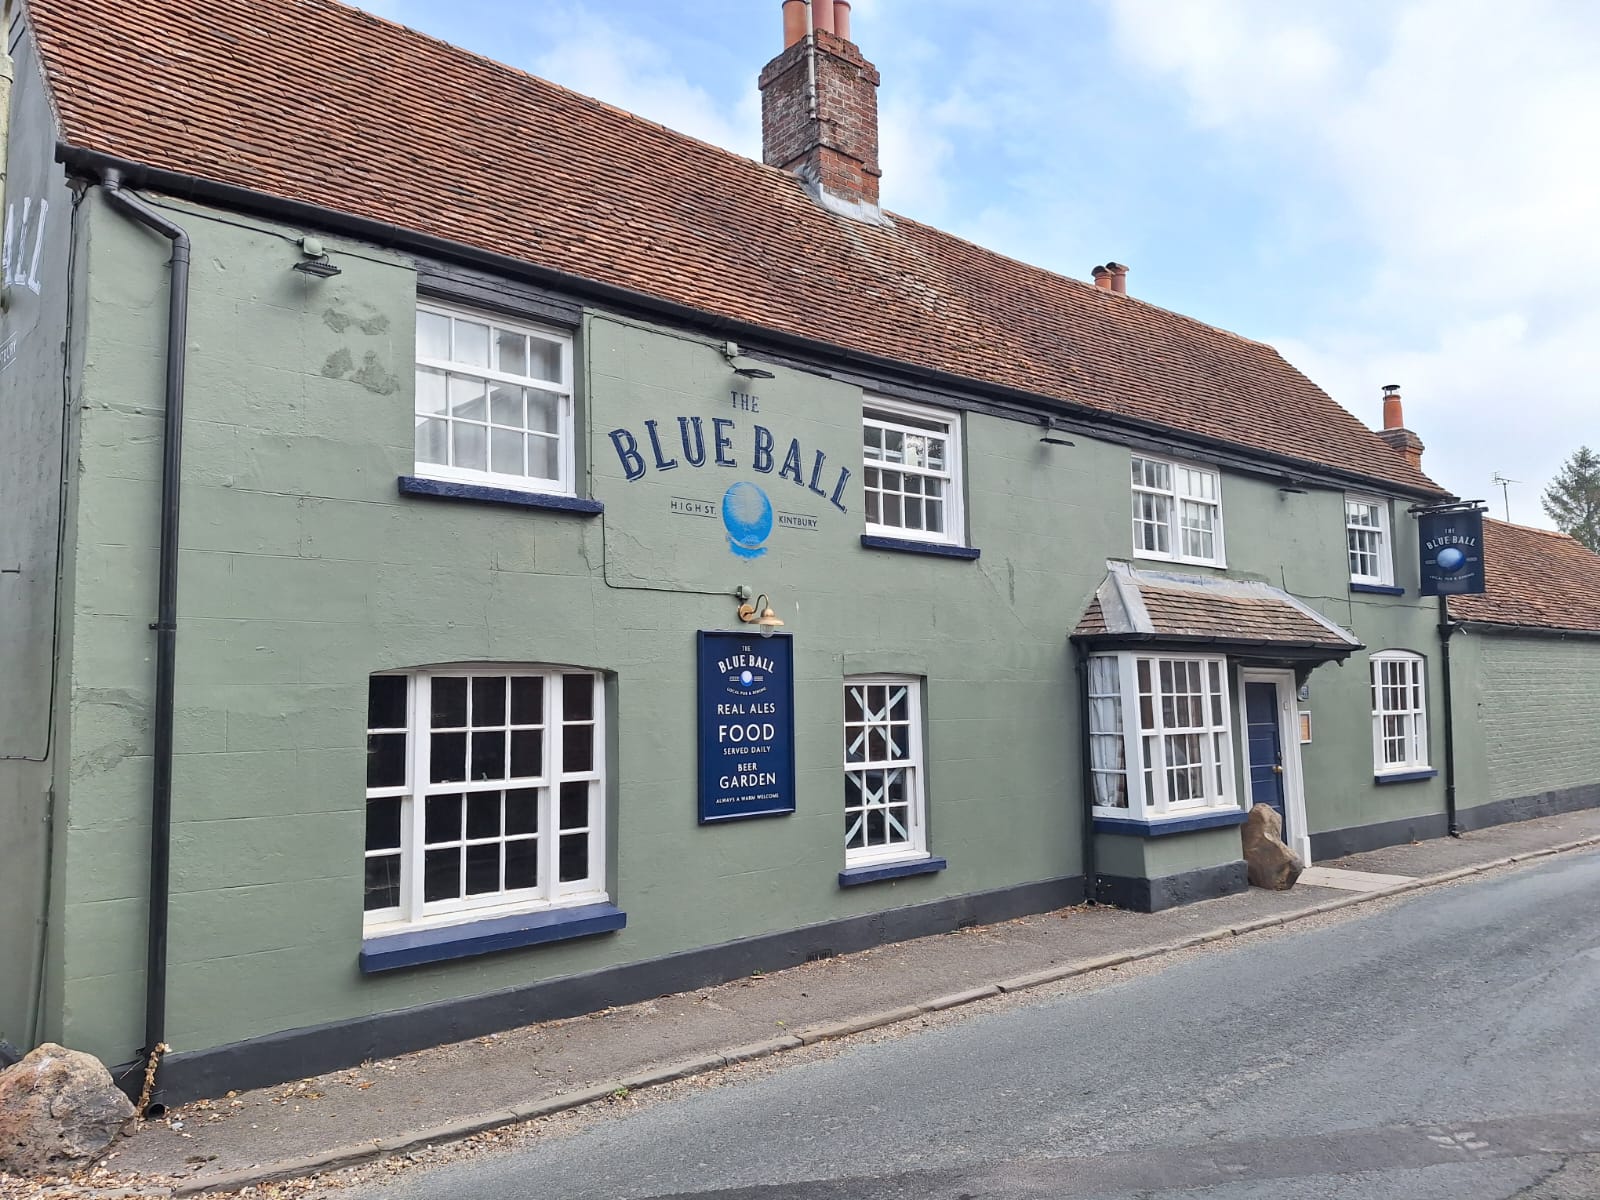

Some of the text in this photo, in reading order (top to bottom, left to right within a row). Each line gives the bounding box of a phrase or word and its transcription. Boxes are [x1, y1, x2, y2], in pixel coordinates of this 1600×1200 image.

[731, 391, 759, 413] THE
[608, 416, 851, 514] BLUE BALL
[670, 500, 702, 513] HIGH
[778, 515, 818, 528] KINTBURY
[1426, 535, 1475, 550] BLUE BALL
[718, 654, 774, 674] BLUE BALL
[717, 702, 776, 715] REAL ALES
[719, 724, 775, 743] FOOD
[723, 745, 771, 755] SERVED DAILY
[737, 762, 757, 772] BEER
[719, 772, 776, 789] GARDEN
[756, 792, 779, 800] WELCOME
